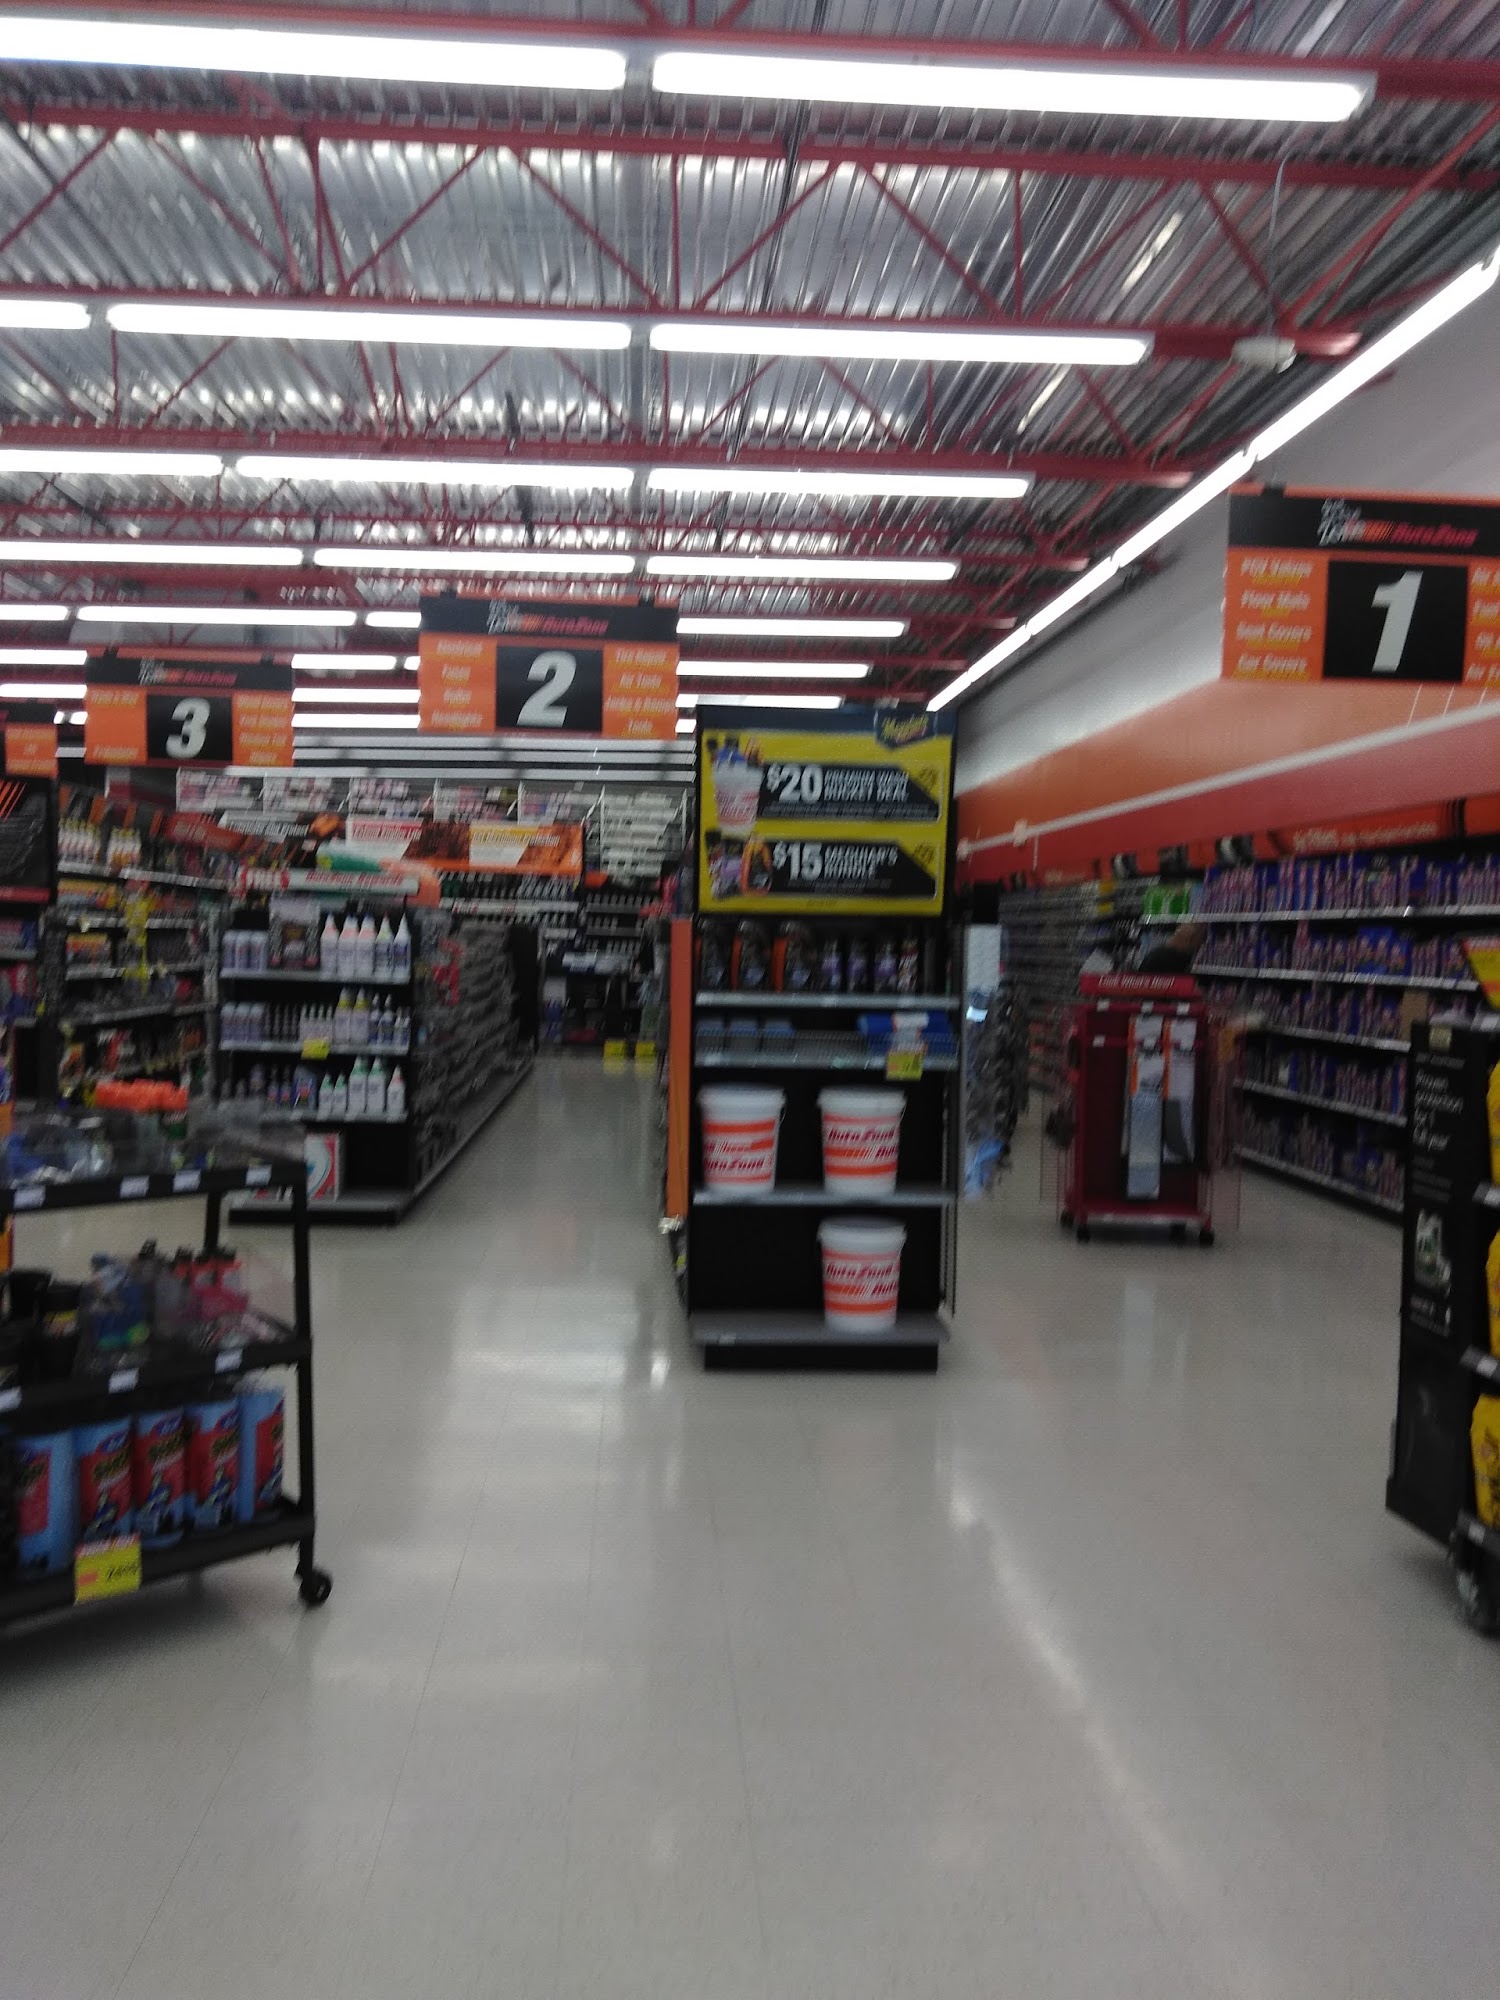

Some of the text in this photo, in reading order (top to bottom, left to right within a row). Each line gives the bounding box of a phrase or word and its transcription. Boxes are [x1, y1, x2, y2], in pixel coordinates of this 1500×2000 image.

[1371, 570, 1424, 673] 1
[516, 650, 577, 728] 2
[165, 697, 211, 760] 3
[766, 762, 824, 804] $20
[772, 840, 824, 882] $15
